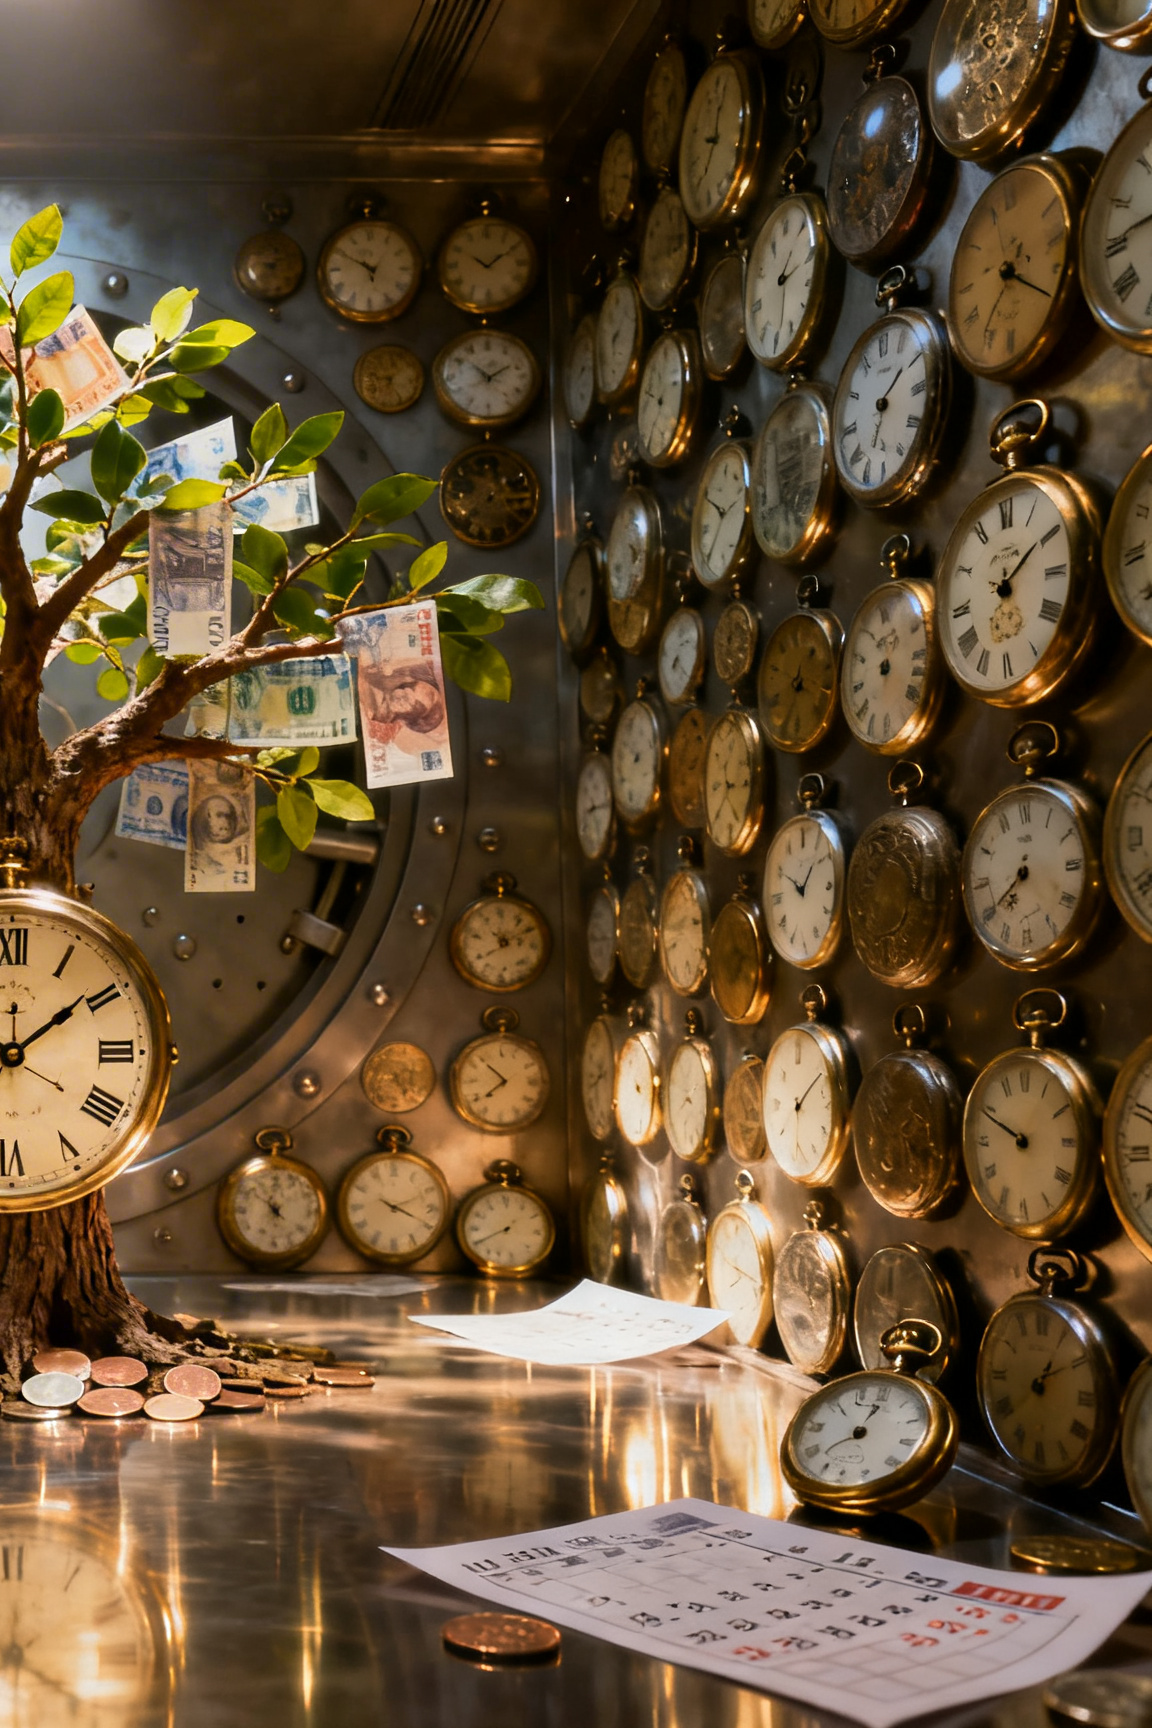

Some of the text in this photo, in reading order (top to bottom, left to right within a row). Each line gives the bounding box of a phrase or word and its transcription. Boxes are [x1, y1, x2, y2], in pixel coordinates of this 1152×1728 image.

[52, 944, 75, 981] I
[85, 982, 122, 1016] II
[98, 1038, 134, 1069] III
